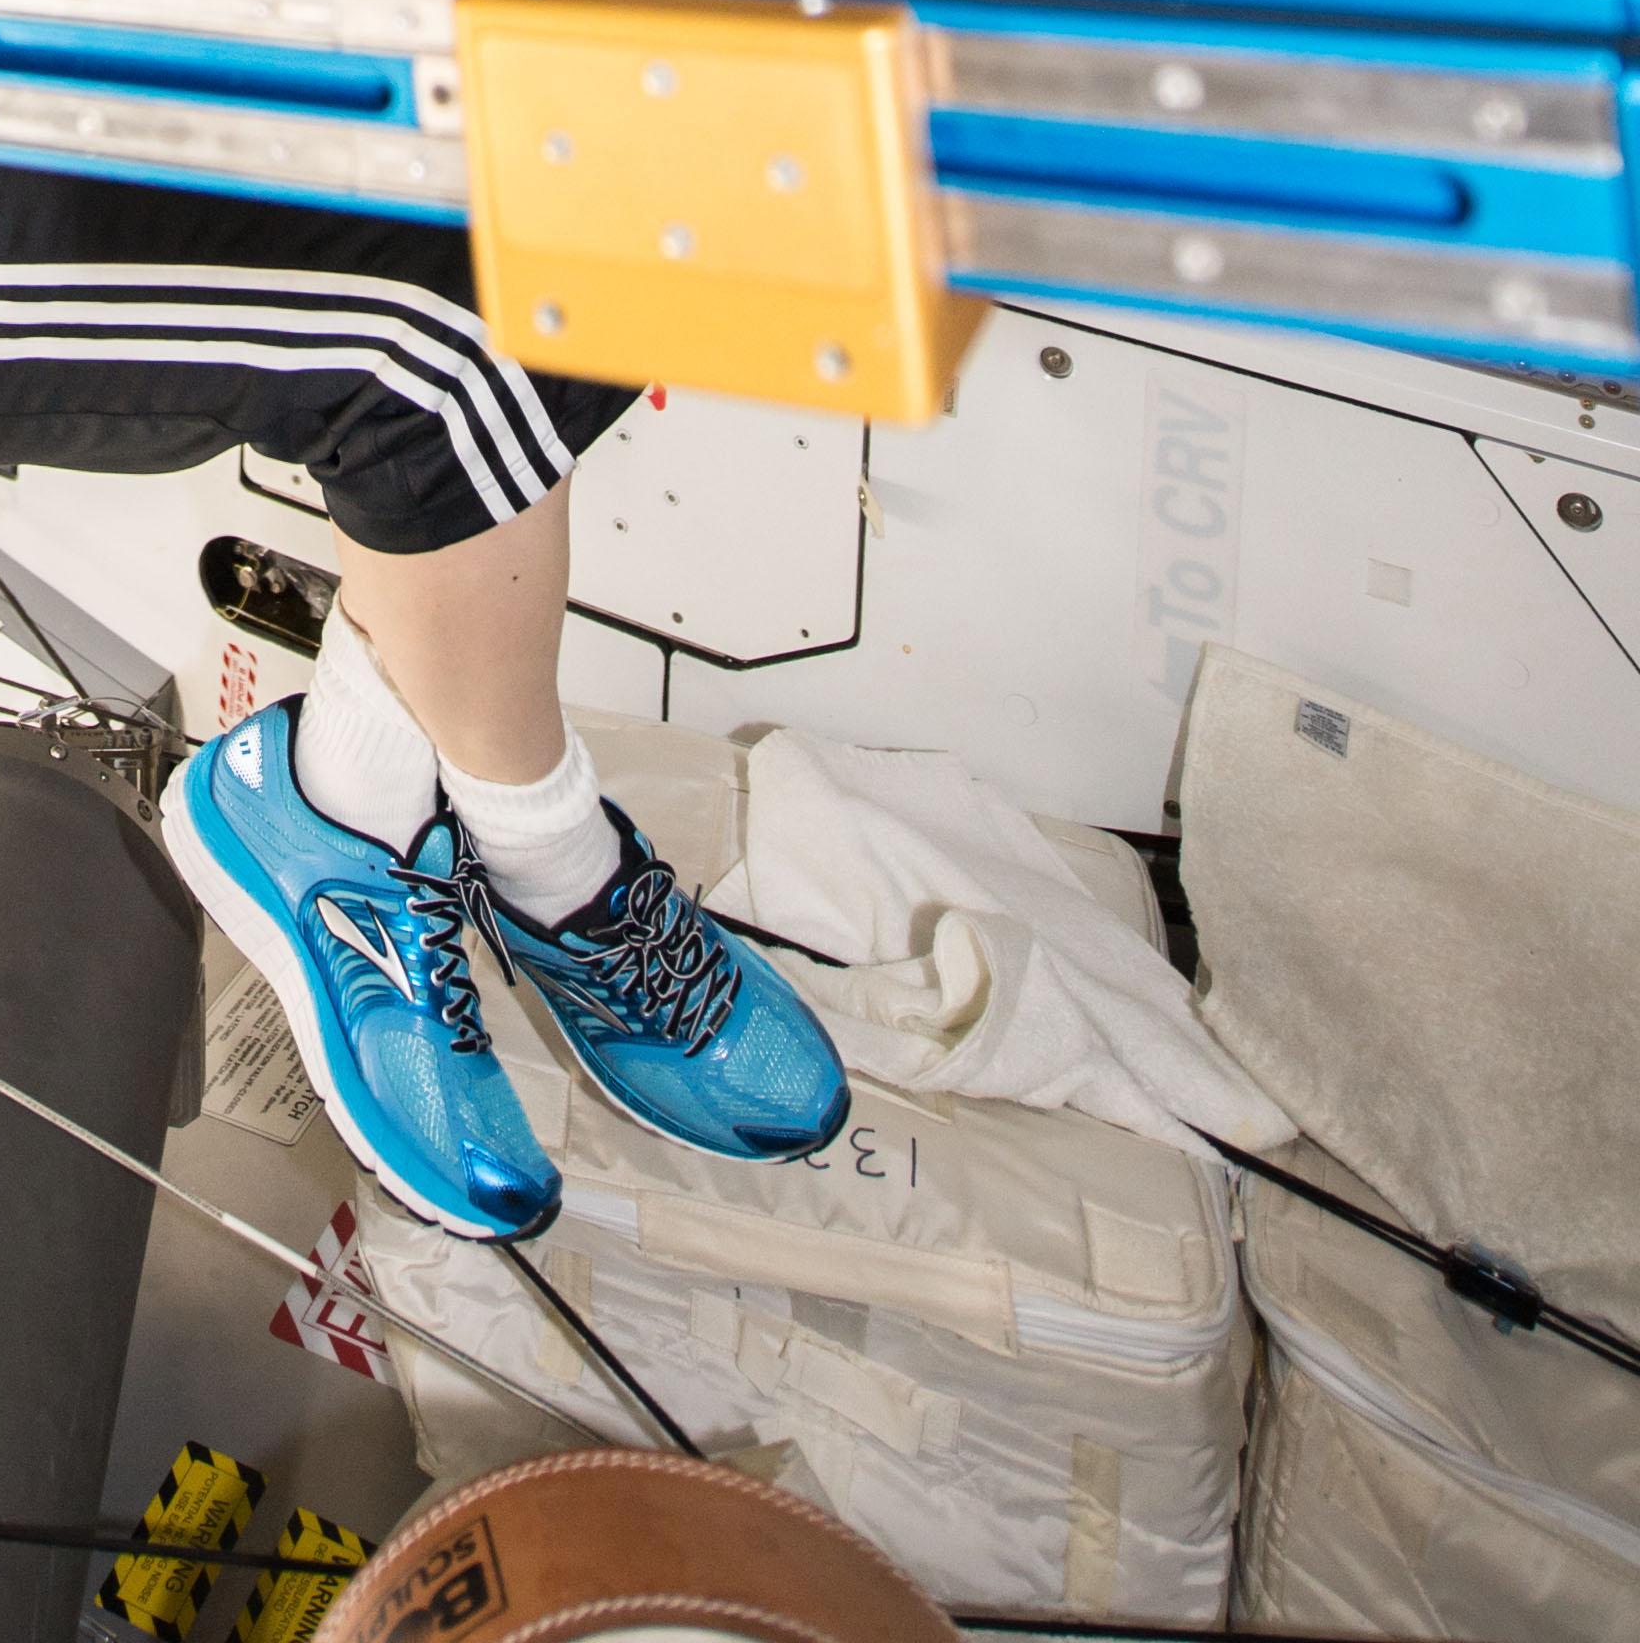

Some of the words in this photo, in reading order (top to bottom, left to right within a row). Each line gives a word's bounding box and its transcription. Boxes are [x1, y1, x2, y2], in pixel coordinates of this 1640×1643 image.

[1156, 386, 1231, 534] CRV
[1148, 553, 1225, 626] To
[174, 1491, 193, 1512] USE
[182, 1473, 219, 1525] POTENTIAL
[137, 1571, 162, 1604] NOISE
